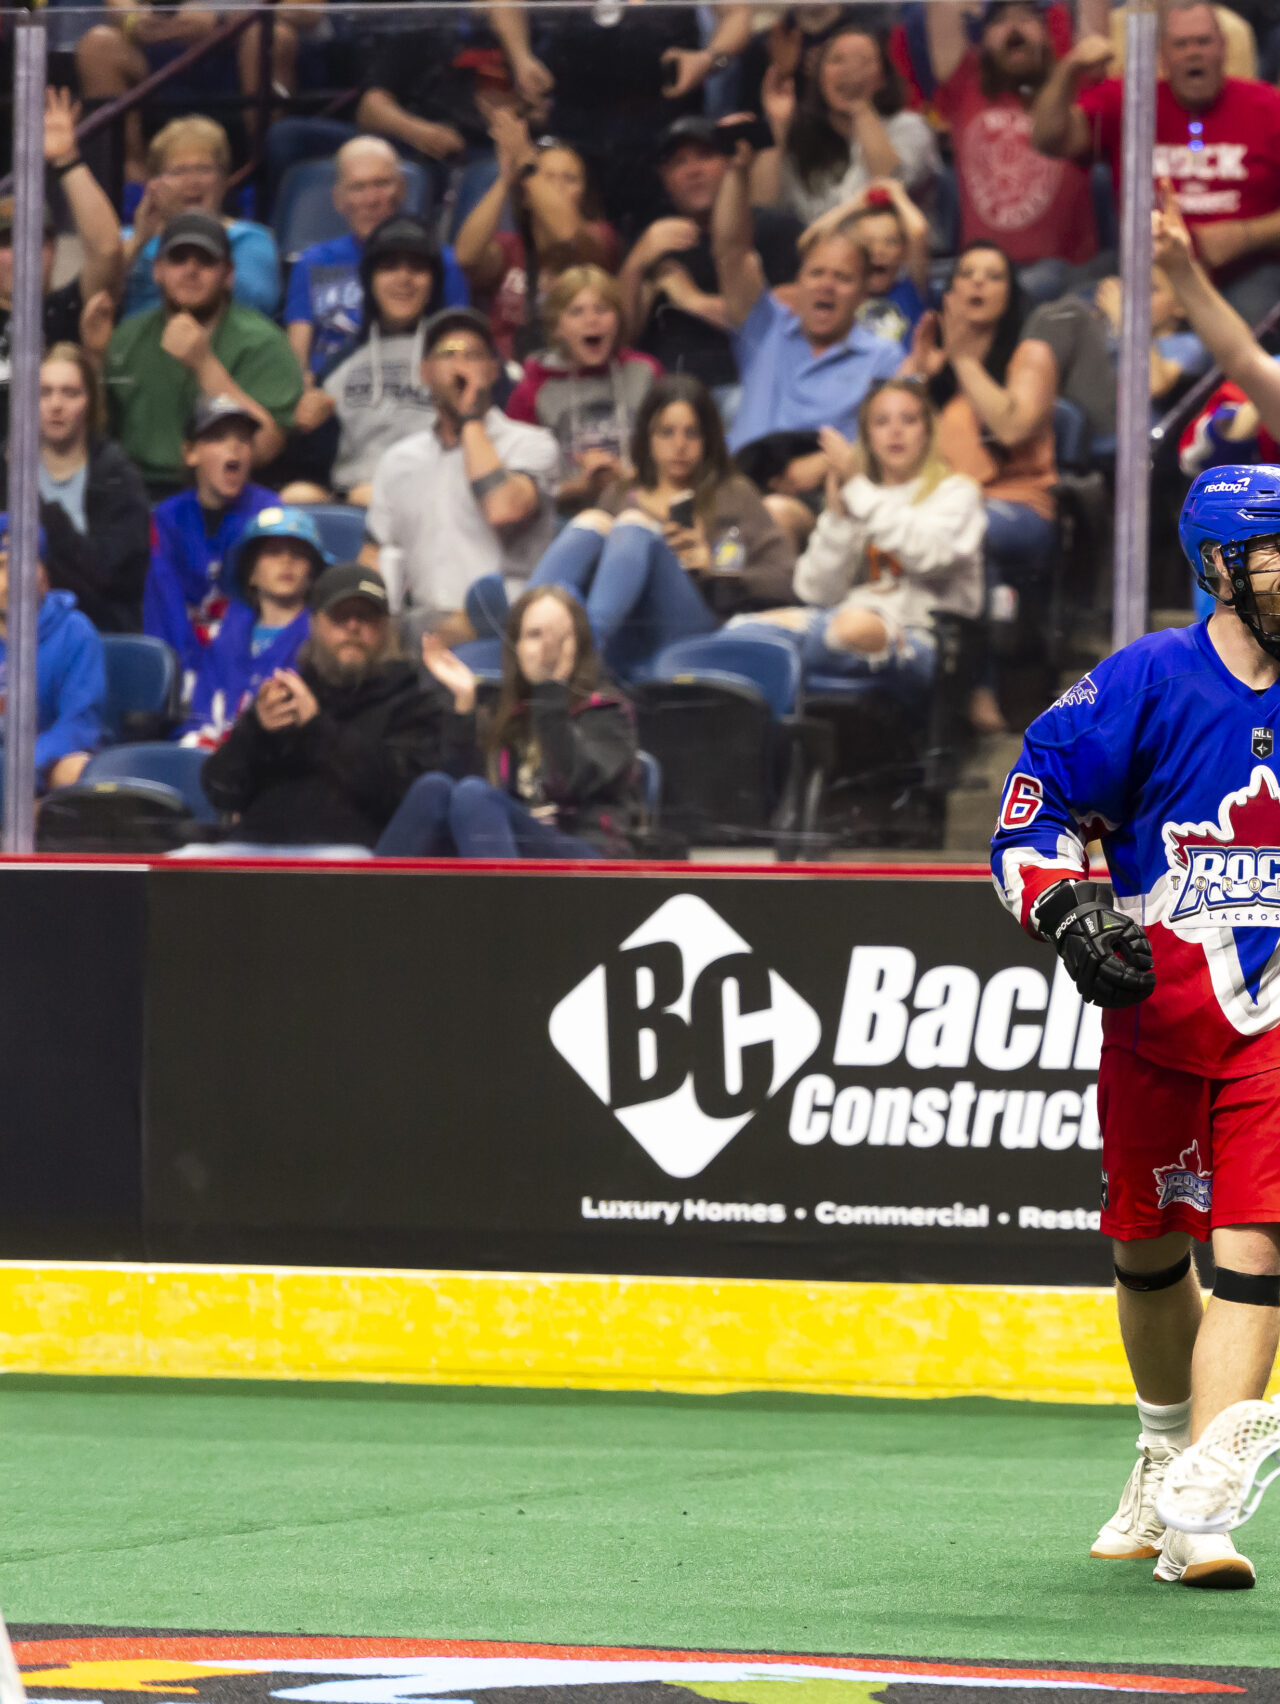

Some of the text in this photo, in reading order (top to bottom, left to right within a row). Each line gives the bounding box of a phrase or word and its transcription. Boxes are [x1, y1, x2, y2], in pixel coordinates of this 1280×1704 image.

[1253, 729, 1273, 739] NLL
[996, 772, 1044, 832] 6
[582, 1196, 681, 1225] Luxury
[683, 1199, 787, 1223] Homes
[815, 1201, 990, 1227] Commercial
